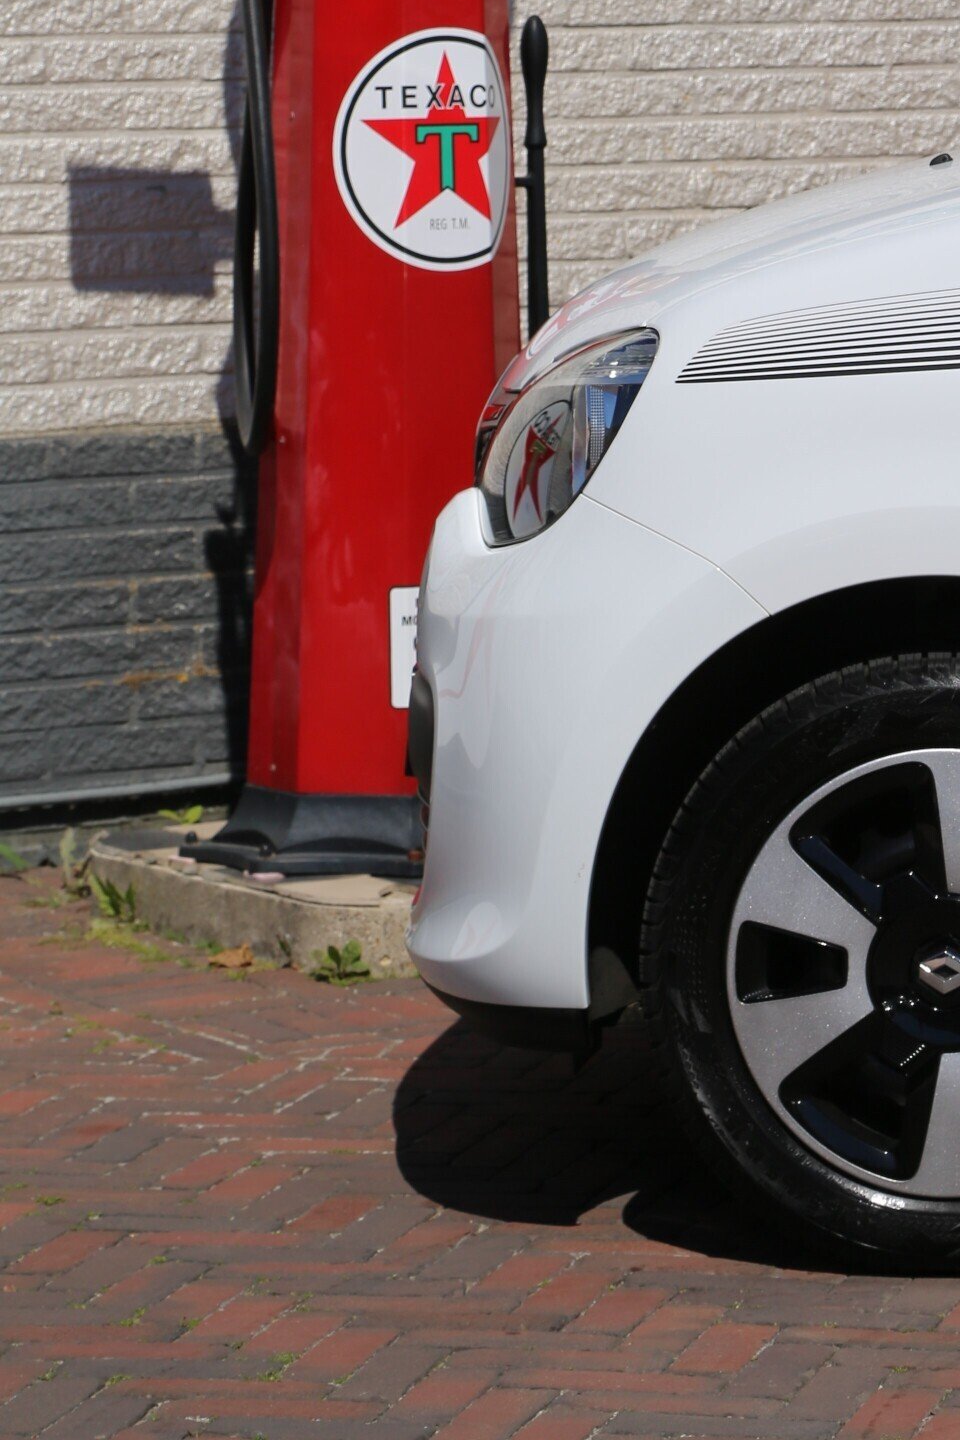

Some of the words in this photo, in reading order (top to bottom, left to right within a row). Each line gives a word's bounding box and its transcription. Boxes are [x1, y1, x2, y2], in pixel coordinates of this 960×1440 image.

[375, 85, 496, 109] TEXACO
[415, 123, 480, 192] T
[429, 218, 448, 230] REG
